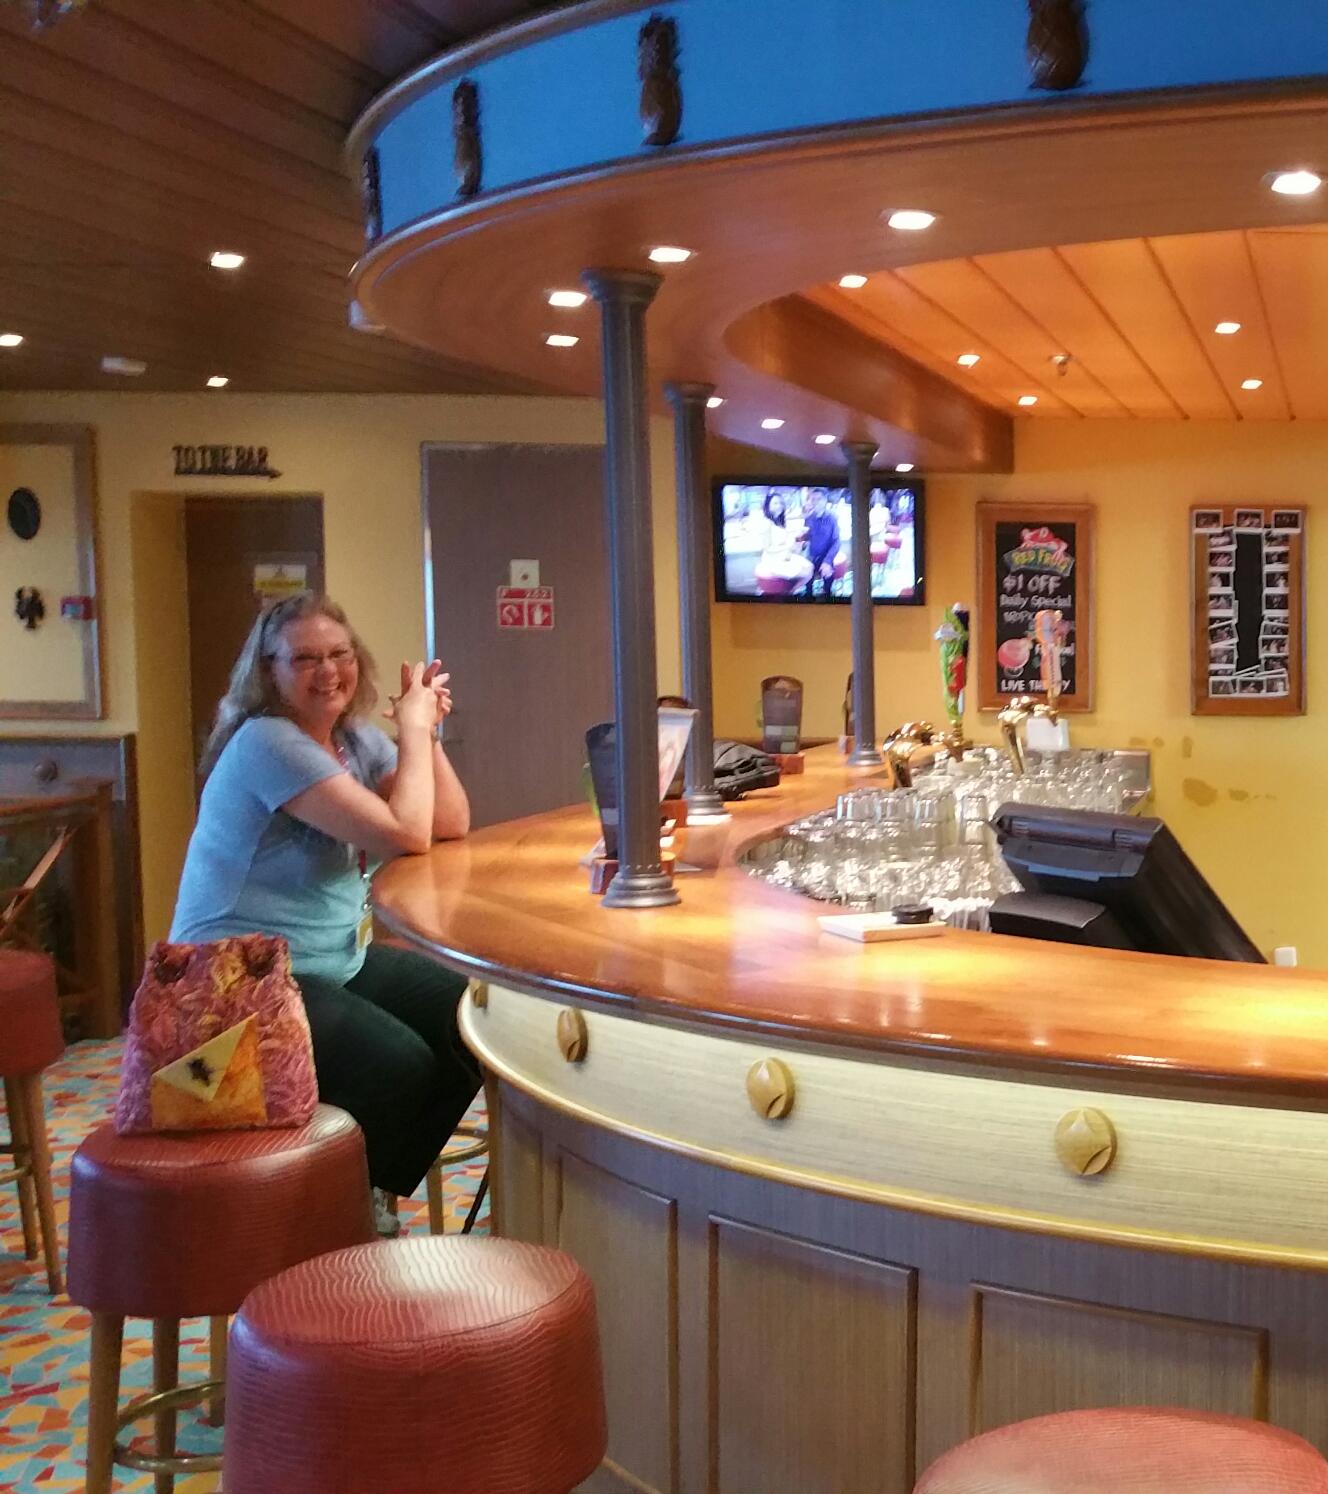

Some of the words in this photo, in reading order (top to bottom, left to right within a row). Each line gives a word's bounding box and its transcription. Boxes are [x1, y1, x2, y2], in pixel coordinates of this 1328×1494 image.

[173, 445, 196, 470] TO
[235, 445, 268, 472] BAR
[1003, 574, 1024, 592] $1
[1027, 574, 1061, 595] OFF
[1000, 593, 1029, 609] Daily
[1030, 595, 1072, 609] Special
[1001, 680, 1025, 691] LIVE
